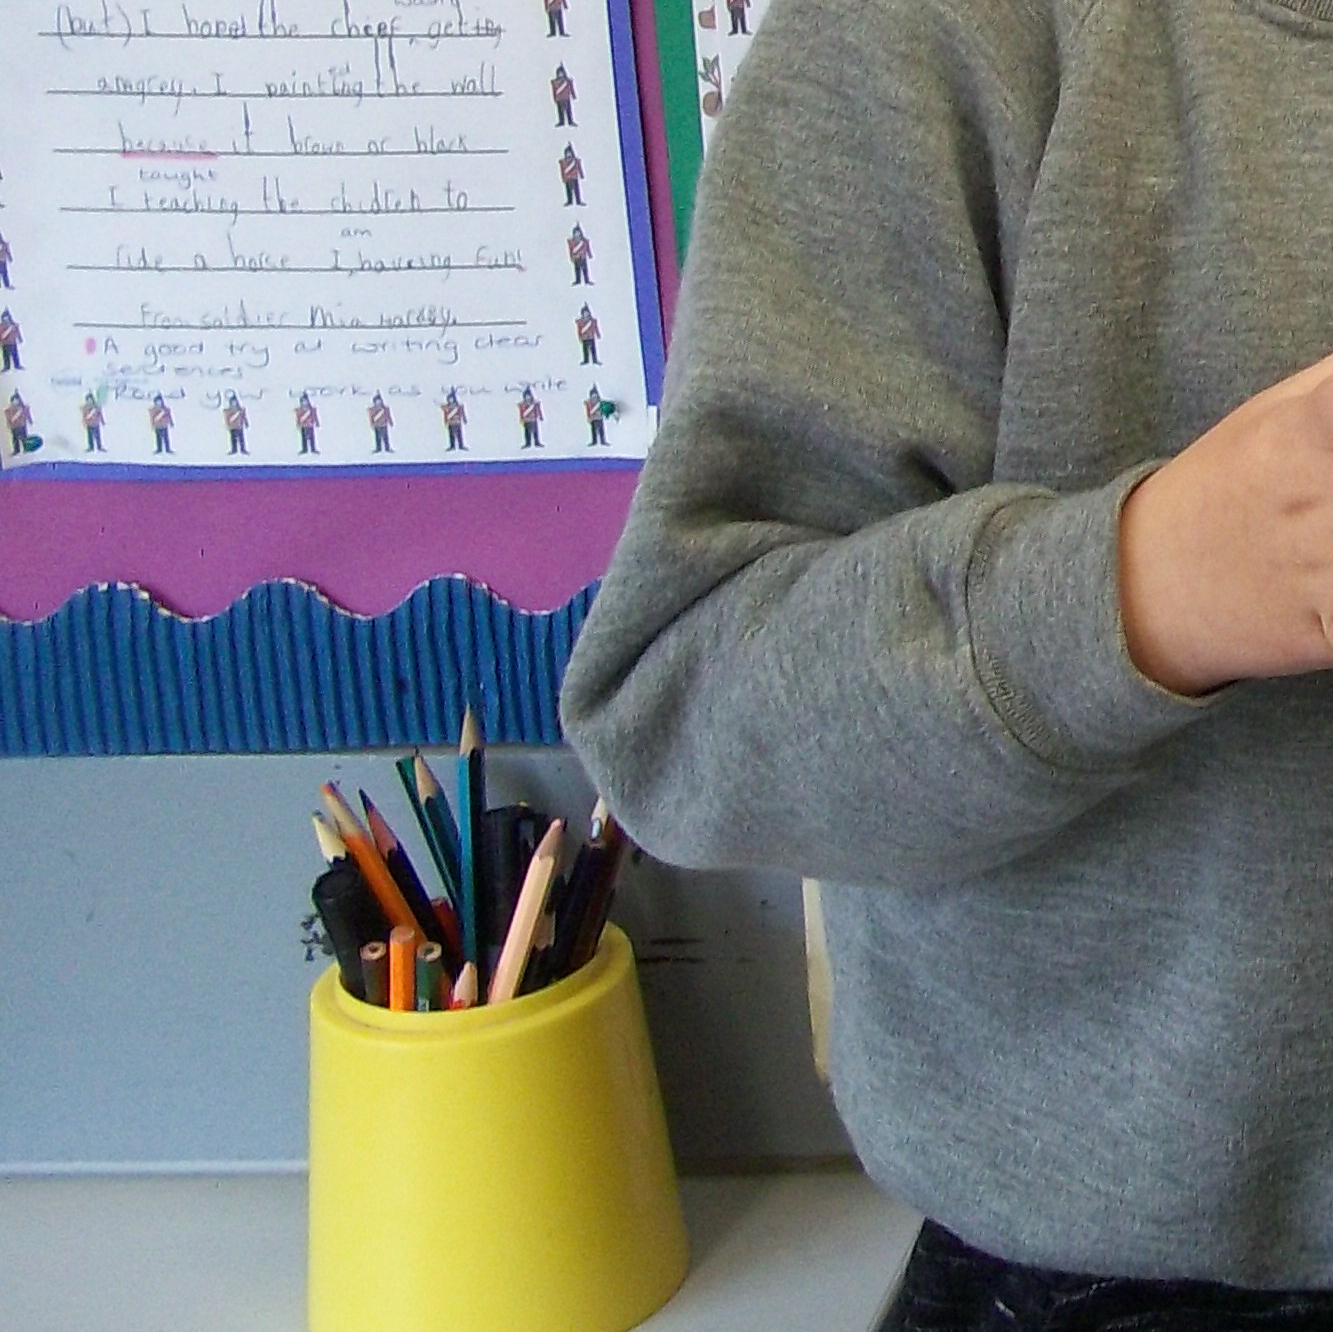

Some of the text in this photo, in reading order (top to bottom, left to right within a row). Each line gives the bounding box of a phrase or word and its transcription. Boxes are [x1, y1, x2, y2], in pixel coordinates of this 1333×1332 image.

[452, 62, 498, 96] wall
[415, 125, 468, 155] black
[139, 167, 216, 189] taught
[445, 180, 468, 211] to
[105, 337, 119, 355] A
[145, 342, 204, 366] good
[228, 342, 269, 368] try
[351, 339, 460, 365] writing
[475, 333, 543, 350] clear
